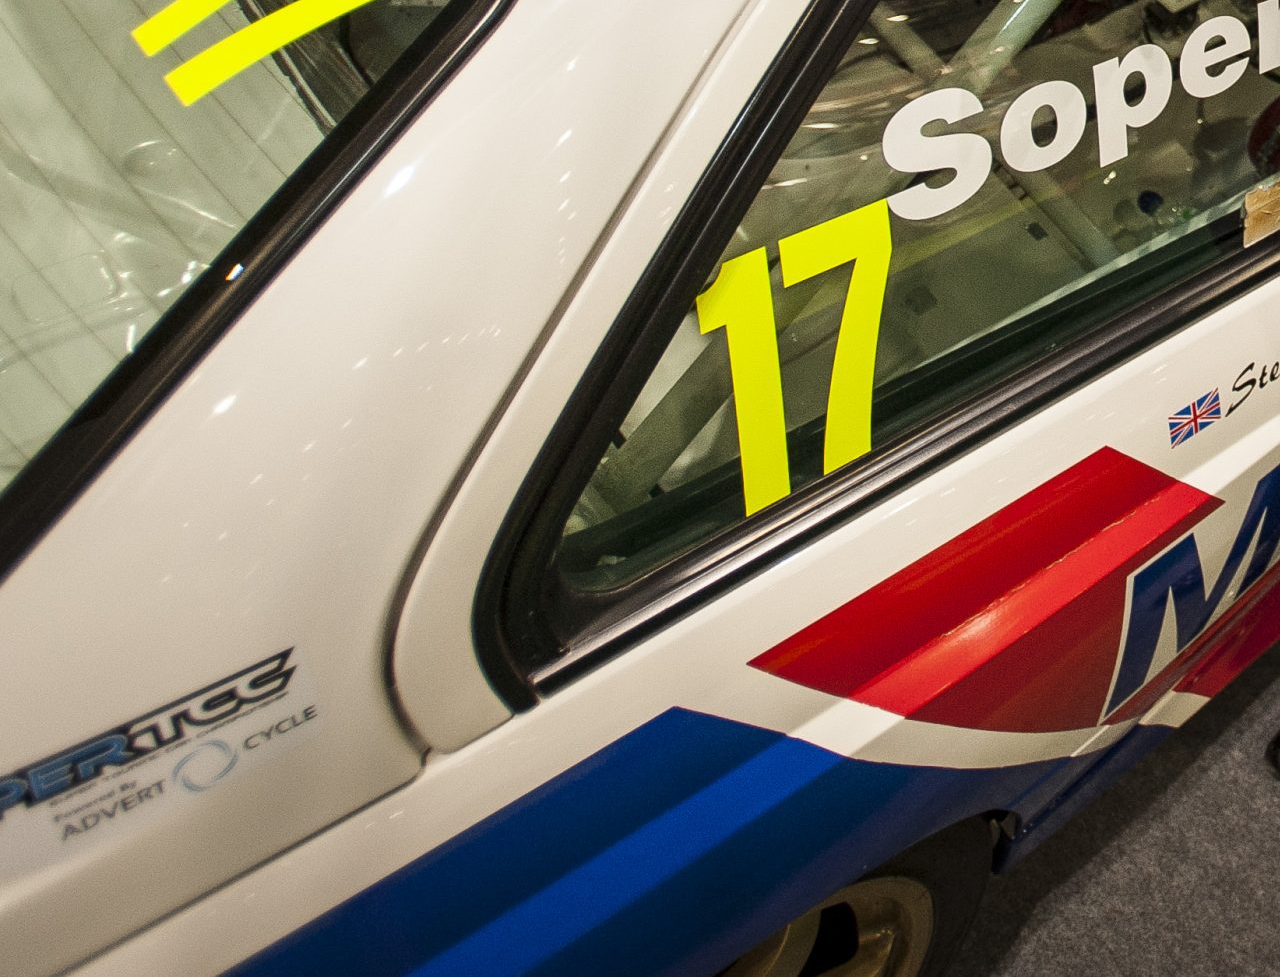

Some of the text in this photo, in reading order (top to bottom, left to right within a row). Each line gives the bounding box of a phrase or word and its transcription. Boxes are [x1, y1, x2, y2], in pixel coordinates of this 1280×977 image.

[695, 196, 892, 517] 17
[61, 704, 319, 842] ADVERT CYCLE
